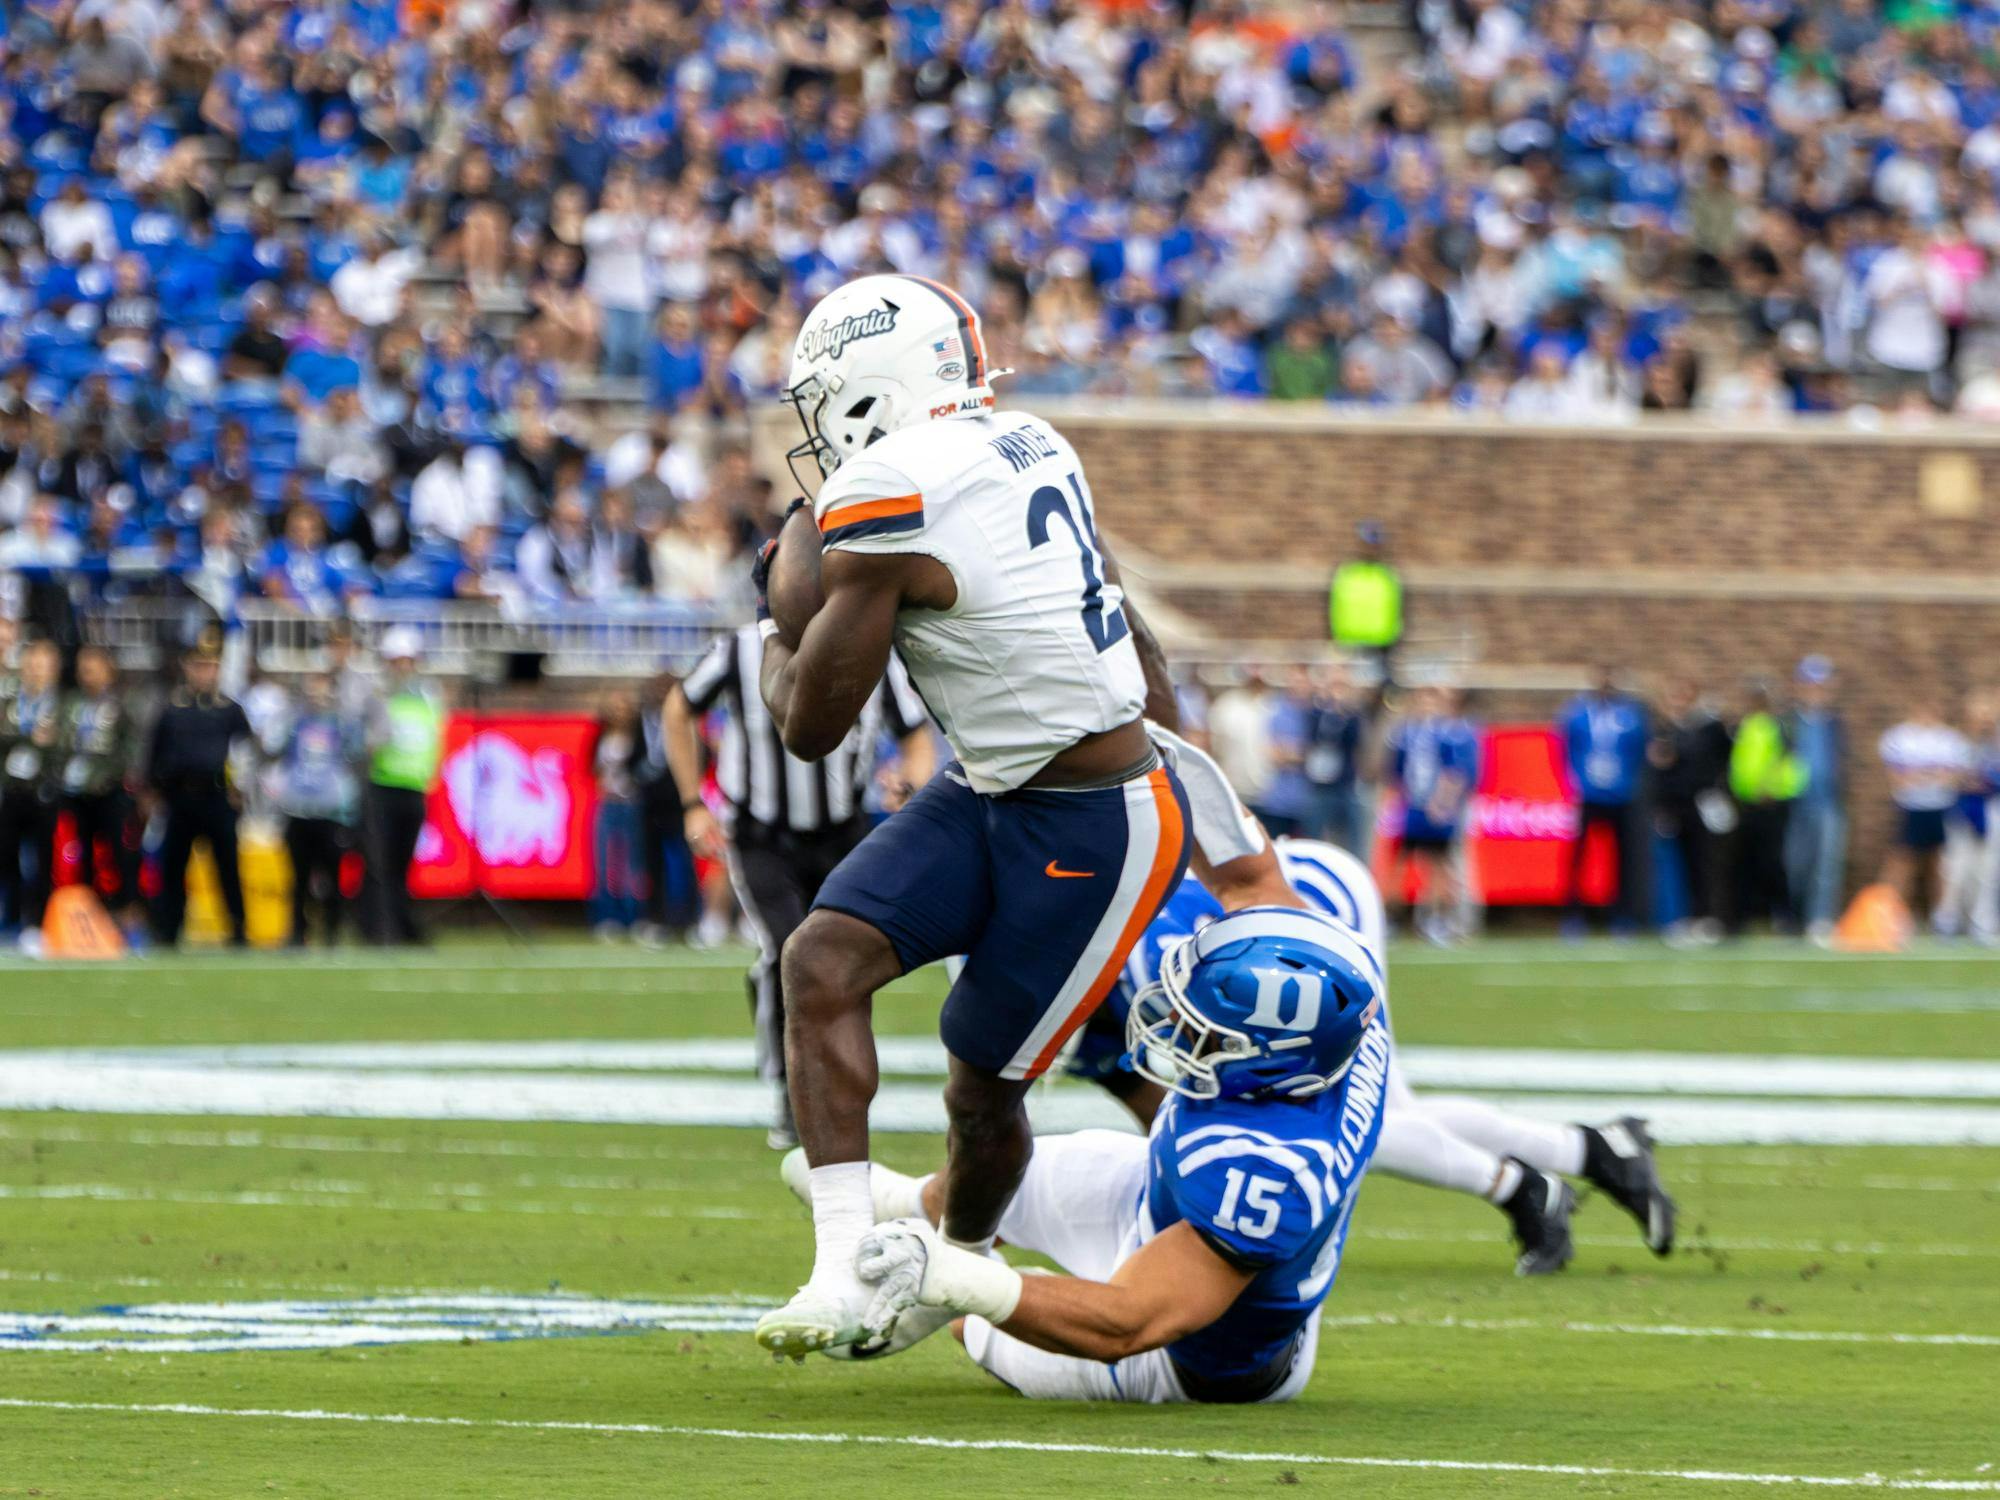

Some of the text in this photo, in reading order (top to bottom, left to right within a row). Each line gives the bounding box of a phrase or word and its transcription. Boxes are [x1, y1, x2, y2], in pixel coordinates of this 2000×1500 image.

[803, 308, 896, 364] Virginia
[930, 402, 957, 419] FOR
[1243, 968, 1322, 1032] D
[1213, 1168, 1287, 1239] 15
